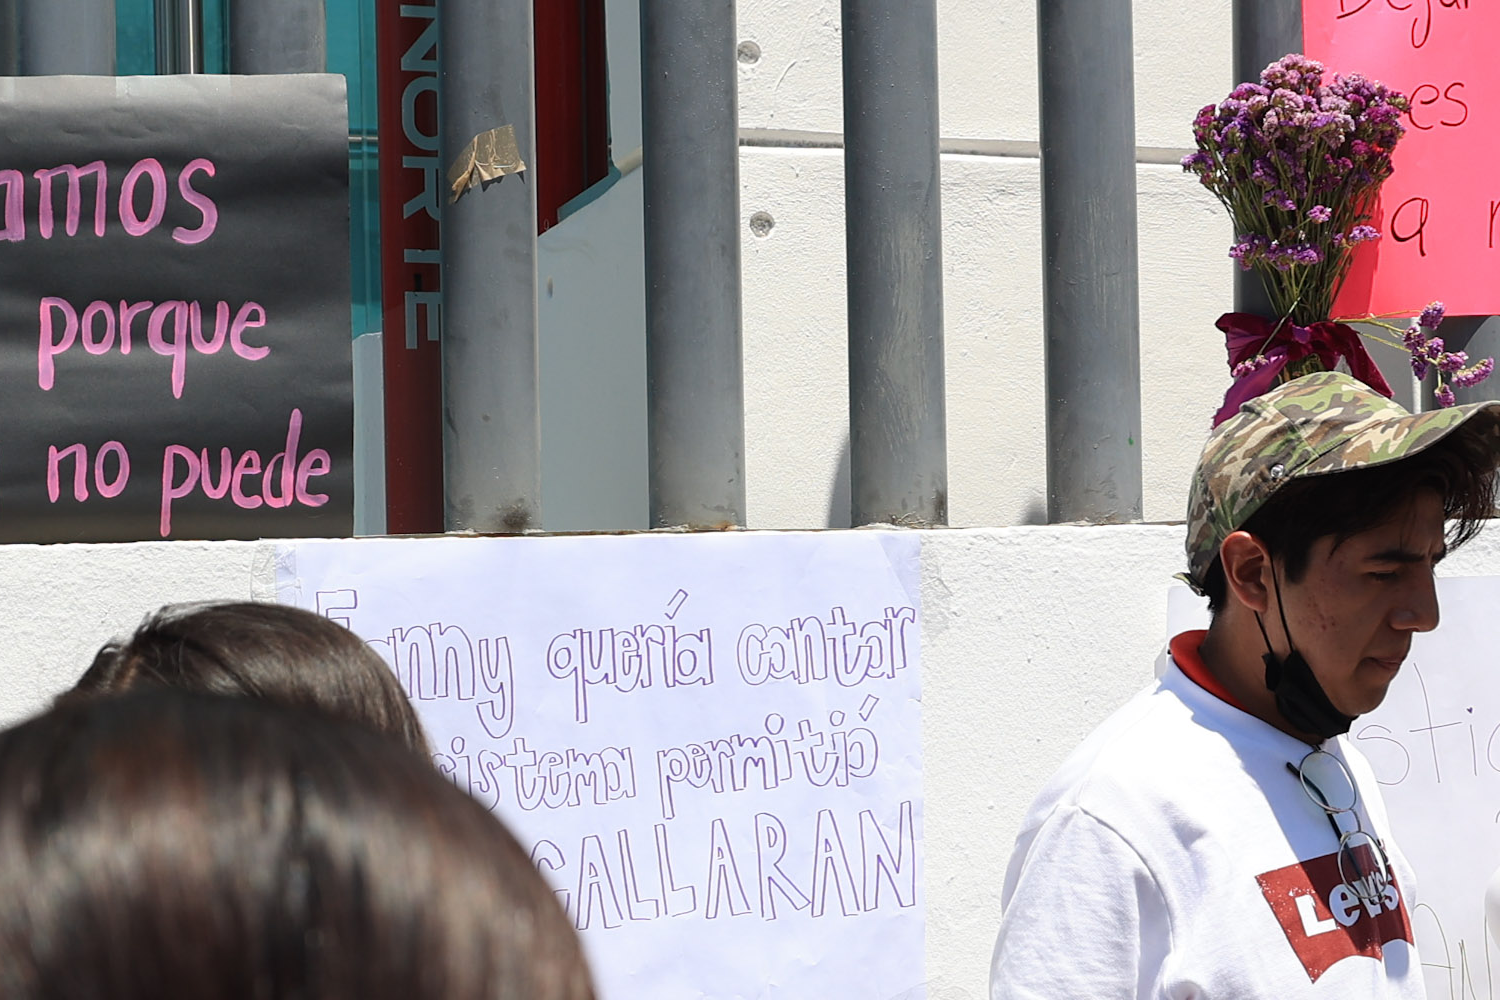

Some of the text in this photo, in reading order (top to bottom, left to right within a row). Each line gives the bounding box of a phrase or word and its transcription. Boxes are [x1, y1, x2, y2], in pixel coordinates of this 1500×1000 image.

[36, 296, 272, 399] porque
[46, 440, 132, 503] no
[159, 407, 332, 537] puede
[546, 588, 714, 724] quería
[737, 606, 916, 687] cantar
[656, 693, 880, 820] permitió
